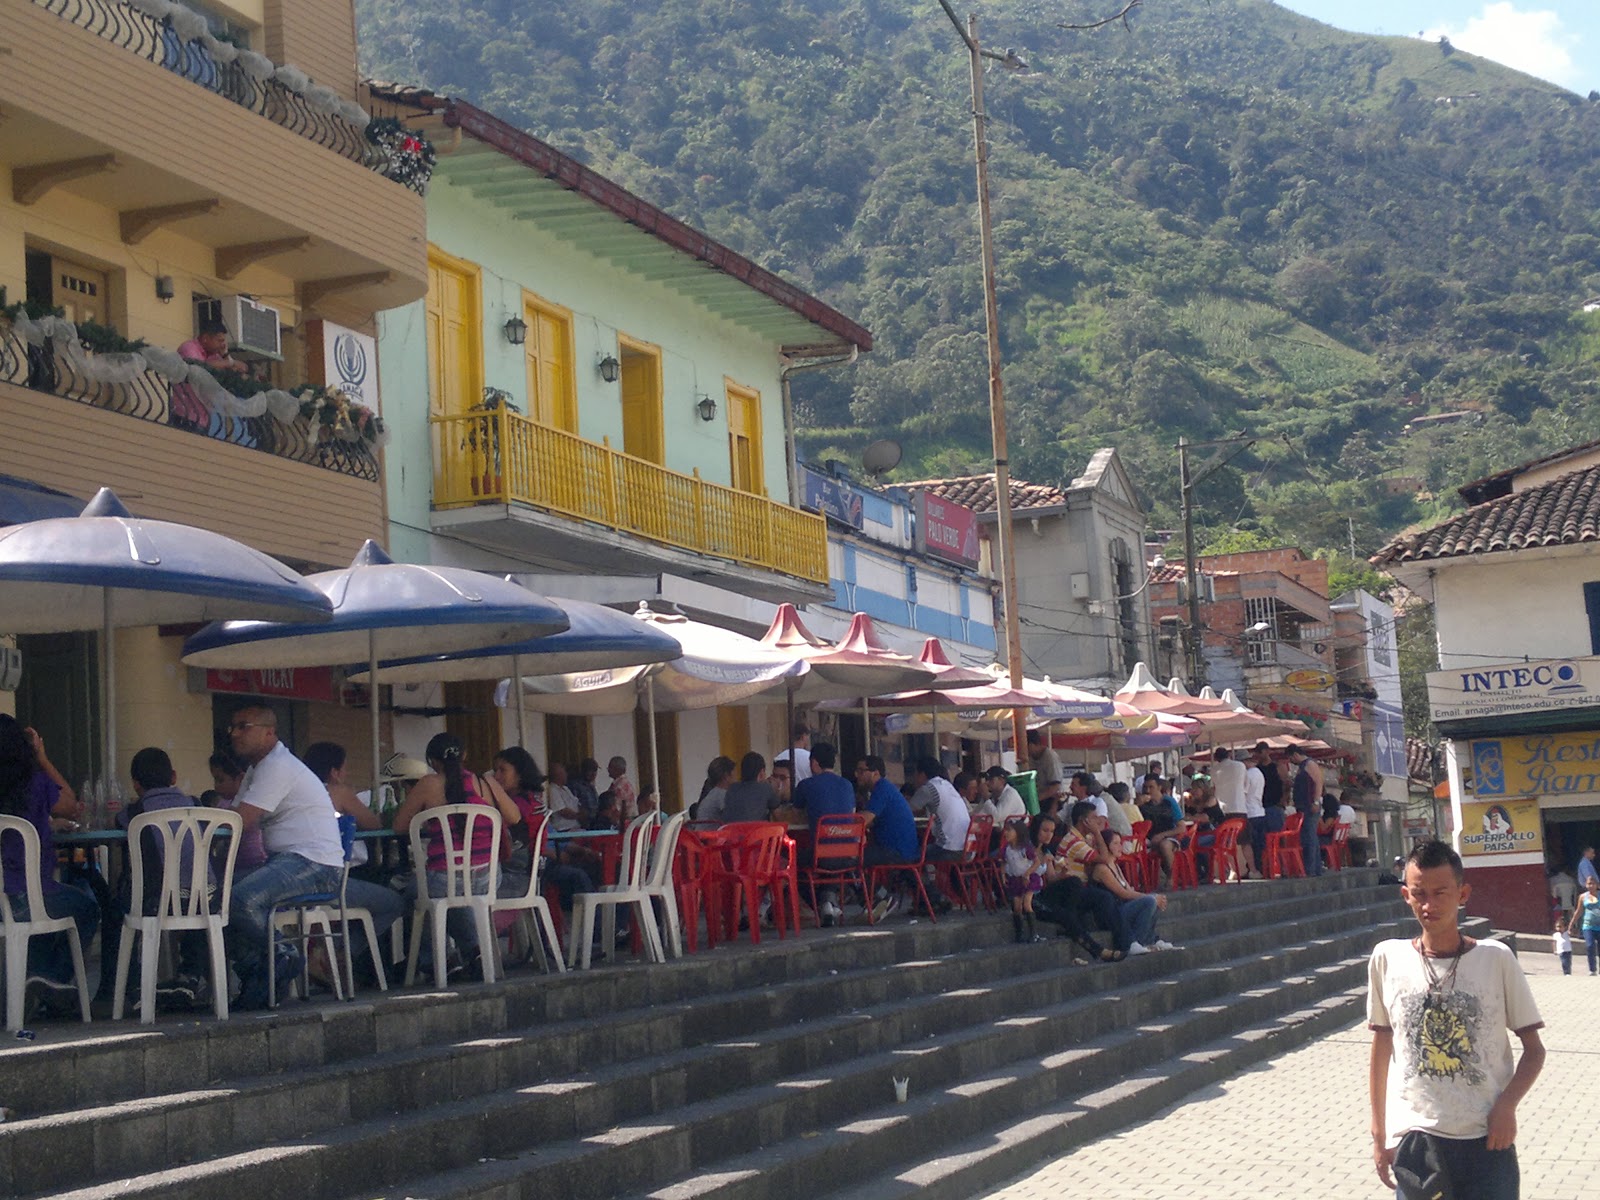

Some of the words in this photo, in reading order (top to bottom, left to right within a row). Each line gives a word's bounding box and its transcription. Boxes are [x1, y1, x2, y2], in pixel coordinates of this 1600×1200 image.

[928, 519, 942, 543] PALO
[260, 667, 295, 689] VICKY
[1463, 831, 1535, 844] SUPERPOLLO
[1483, 842, 1514, 851] PAISA
